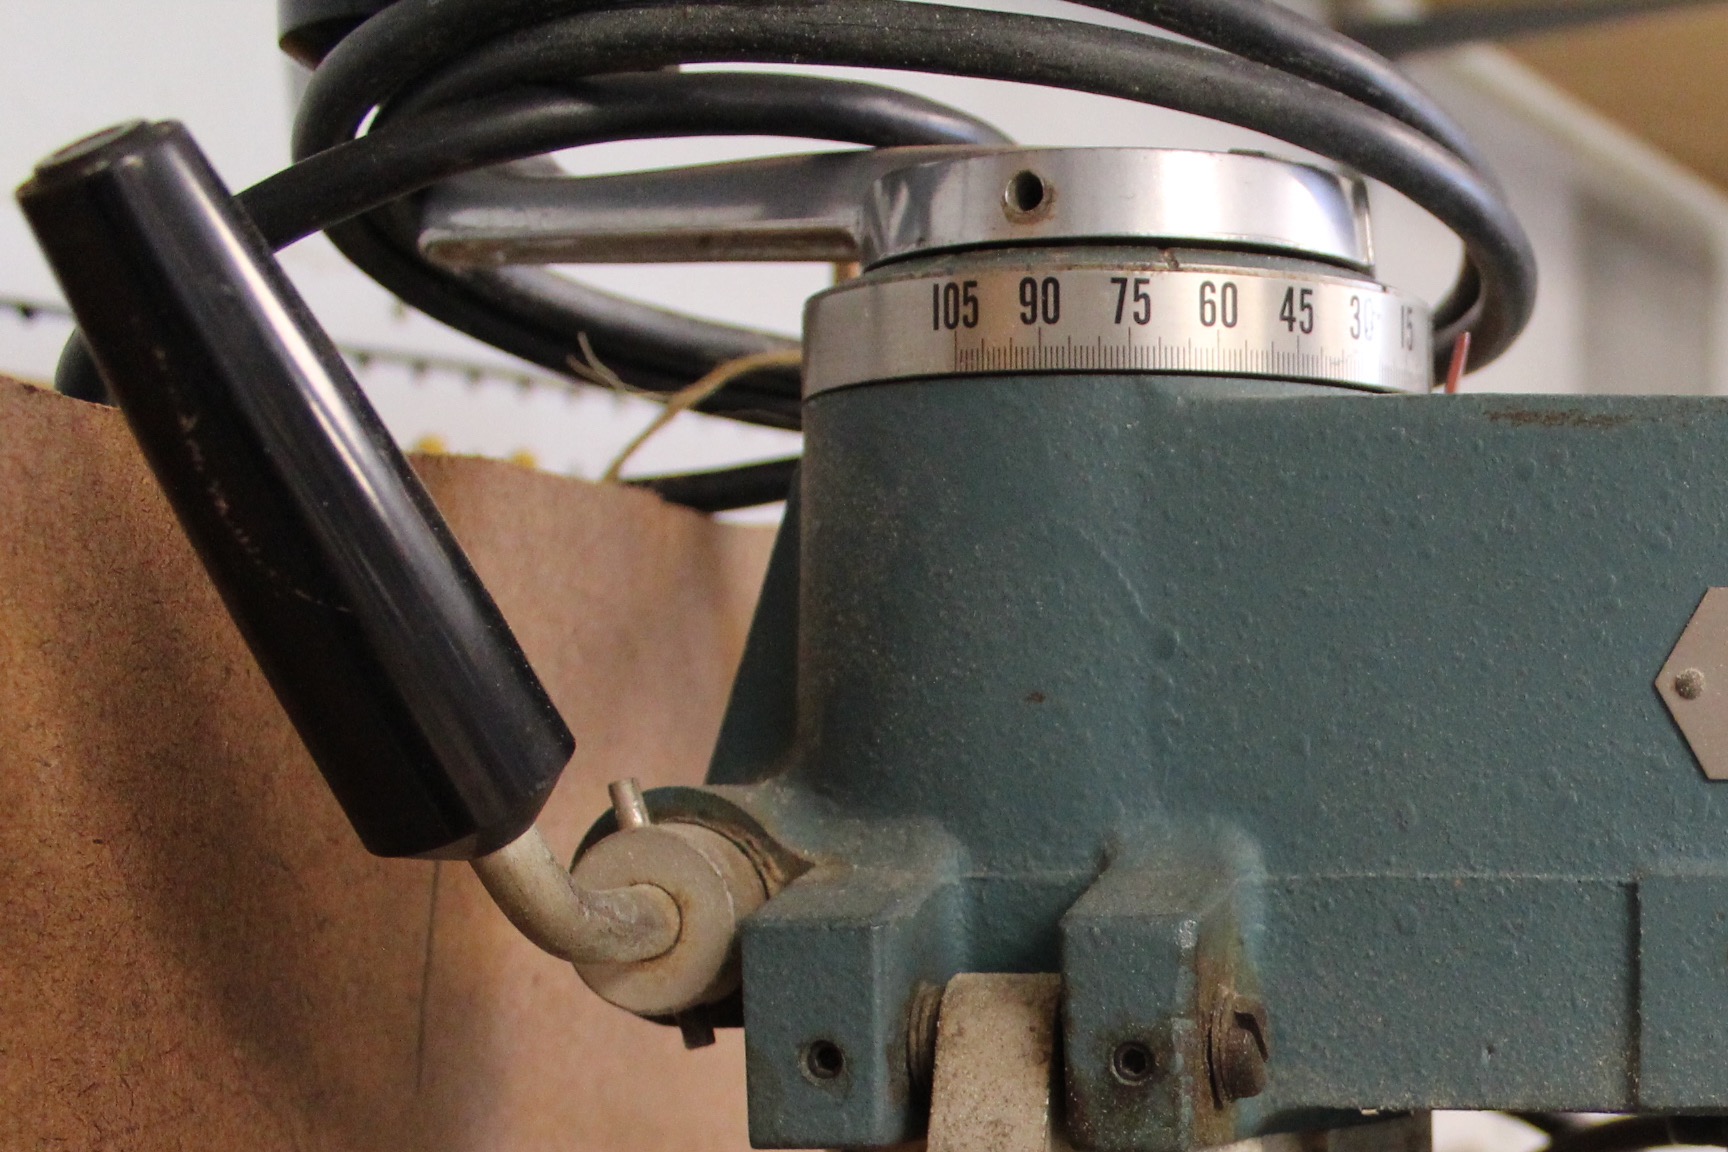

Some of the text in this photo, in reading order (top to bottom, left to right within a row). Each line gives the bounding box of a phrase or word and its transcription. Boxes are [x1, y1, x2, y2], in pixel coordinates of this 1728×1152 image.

[932, 279, 980, 331] 105
[1018, 276, 1061, 326] 90
[1110, 277, 1151, 326] 75
[1199, 280, 1238, 328] 60
[1278, 286, 1314, 335] 45
